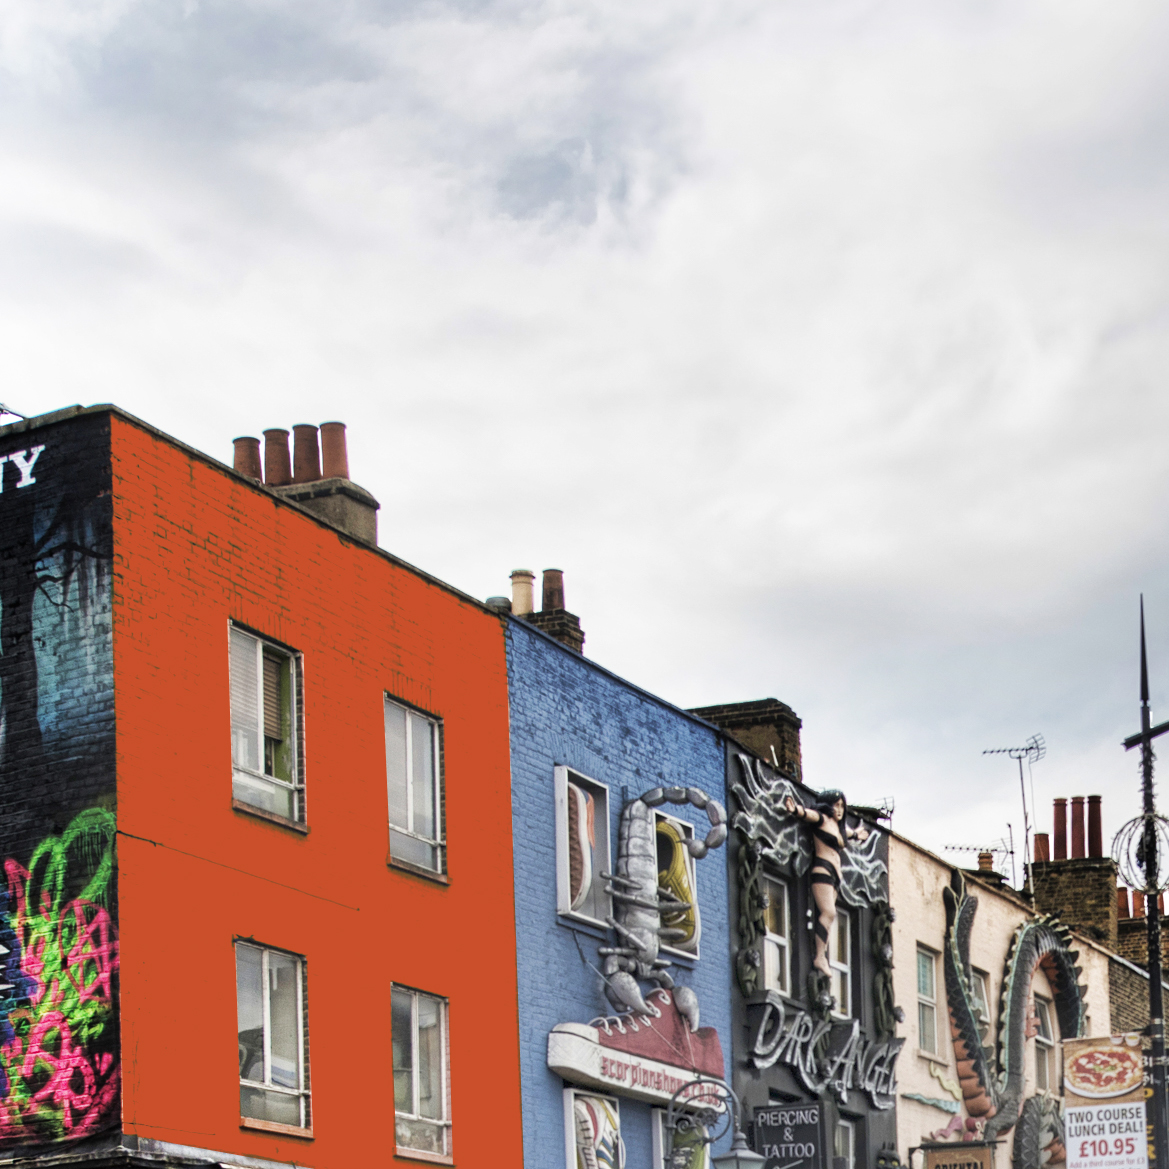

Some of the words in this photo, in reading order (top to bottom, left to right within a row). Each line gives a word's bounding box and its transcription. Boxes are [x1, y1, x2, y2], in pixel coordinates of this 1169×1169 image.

[758, 1110, 819, 1127] PIERCING
[1068, 1111, 1093, 1124] TWO
[1096, 1107, 1142, 1122] COURSE
[783, 1127, 794, 1142] &
[1068, 1123, 1105, 1138] LUNCH
[1109, 1120, 1143, 1135] DEAL!
[762, 1143, 815, 1158] TATTOO
